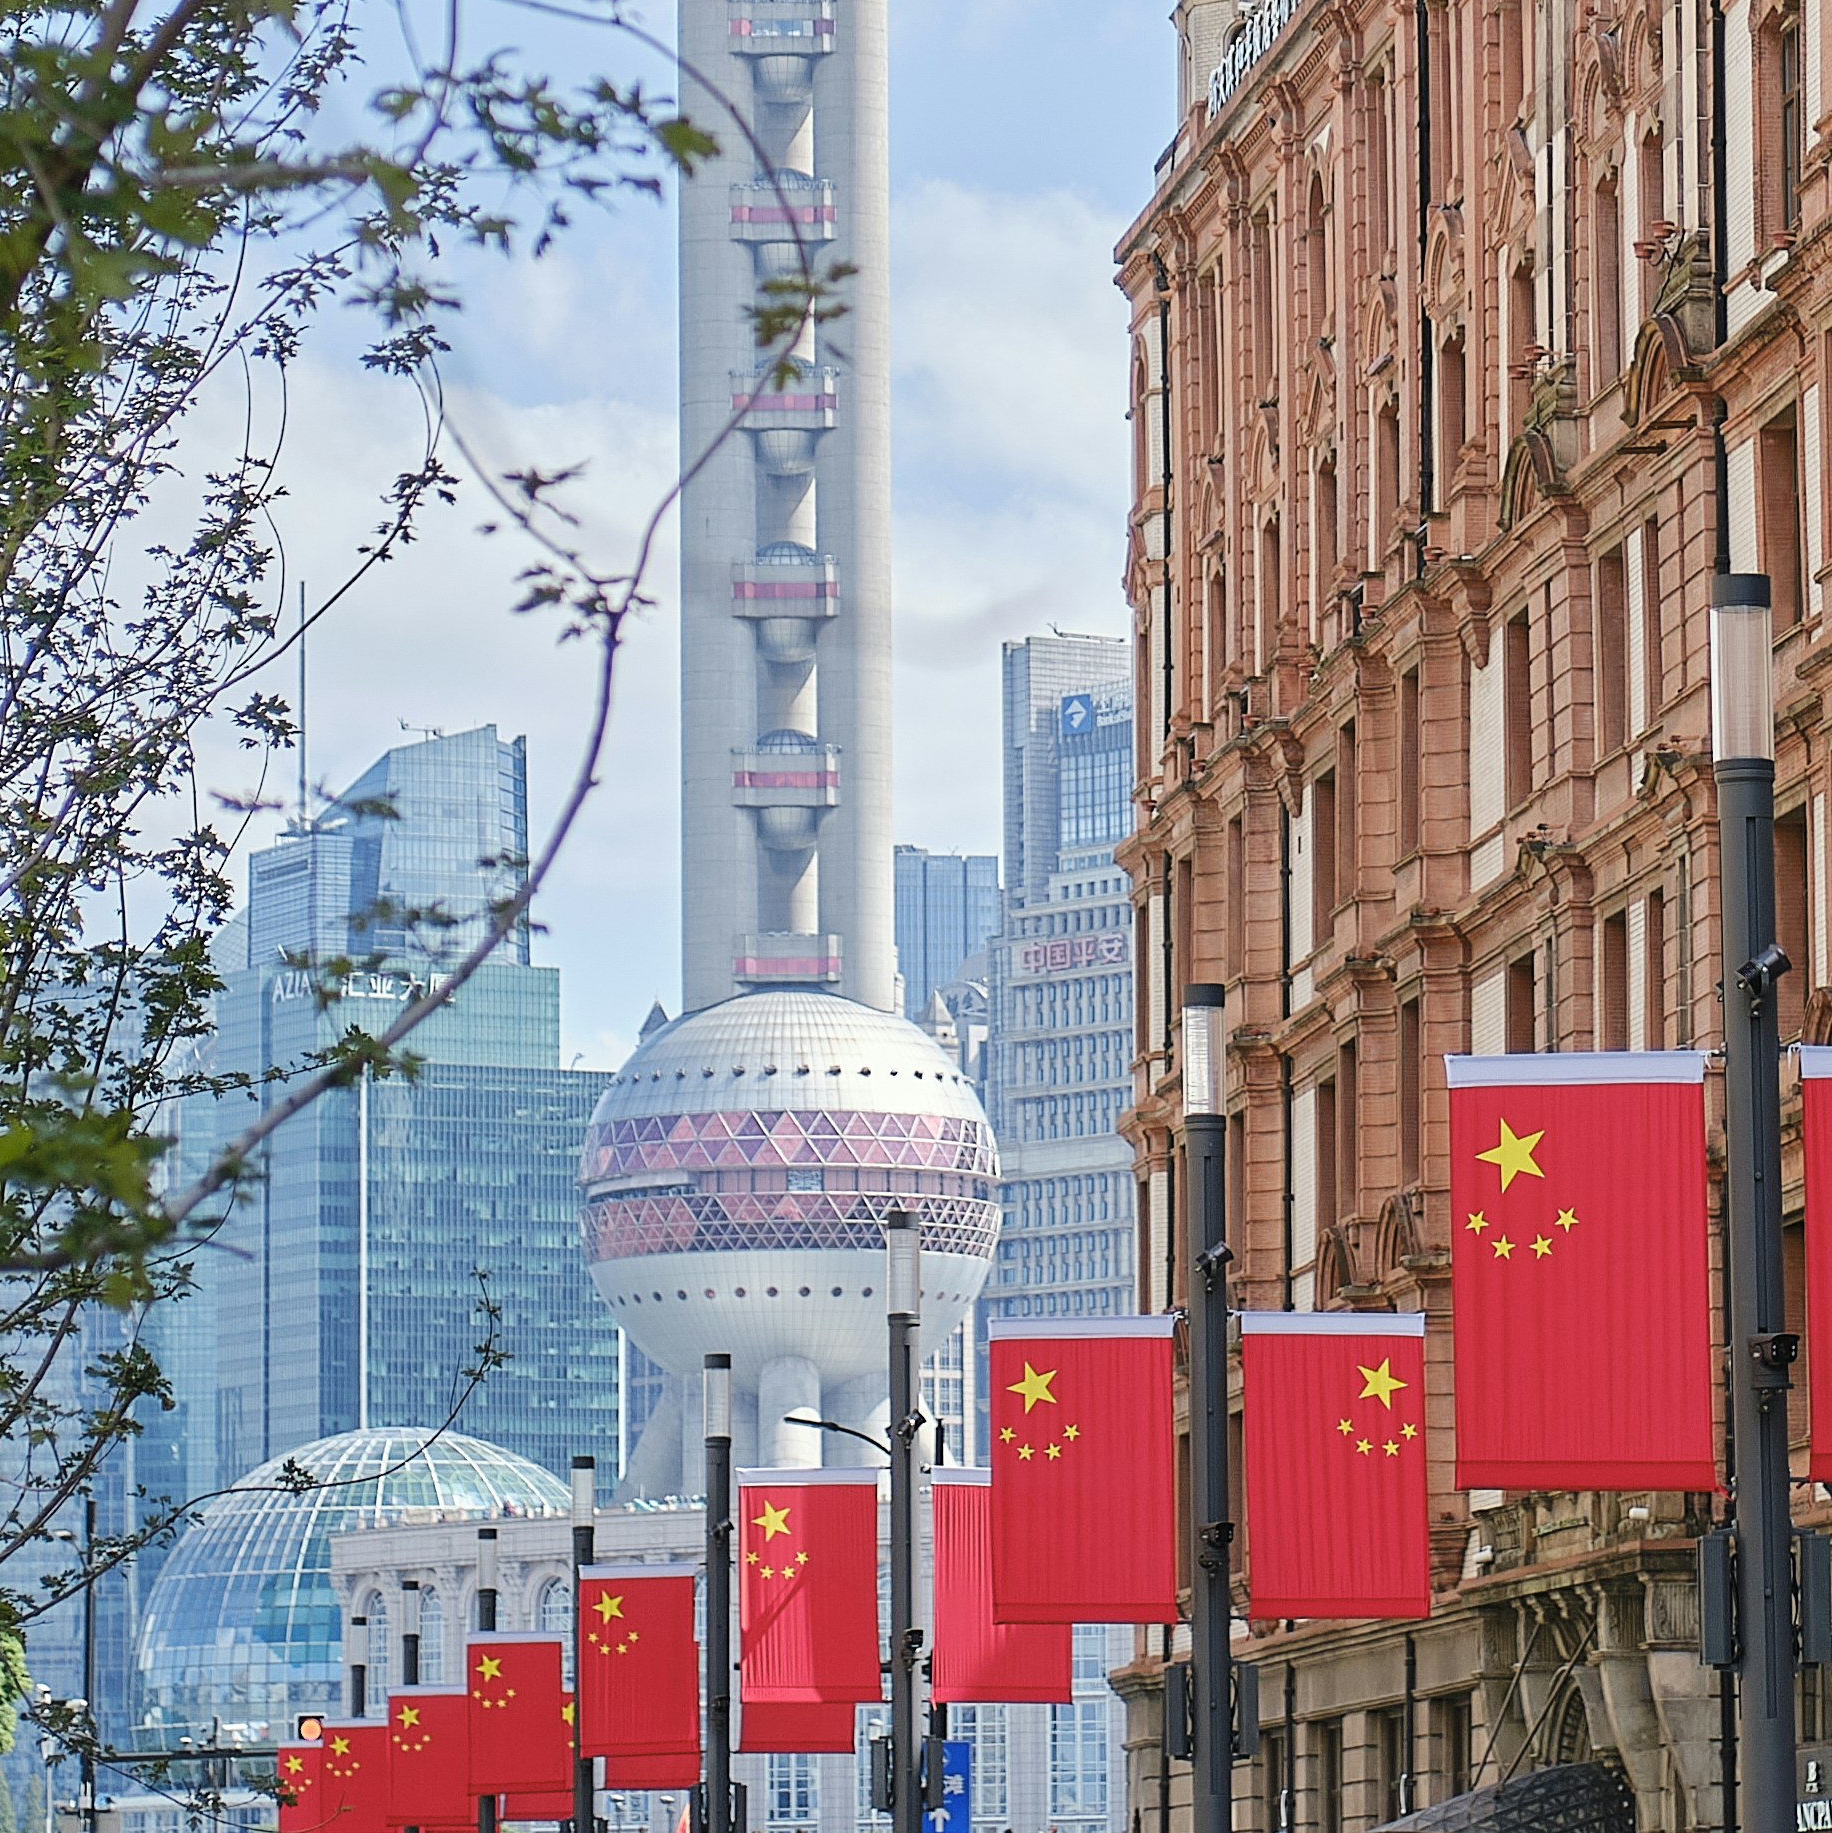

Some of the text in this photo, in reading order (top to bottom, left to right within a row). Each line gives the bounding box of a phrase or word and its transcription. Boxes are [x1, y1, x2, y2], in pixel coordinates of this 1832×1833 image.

[1021, 932, 1124, 974] 中国平安
[272, 970, 312, 1003] AZIA
